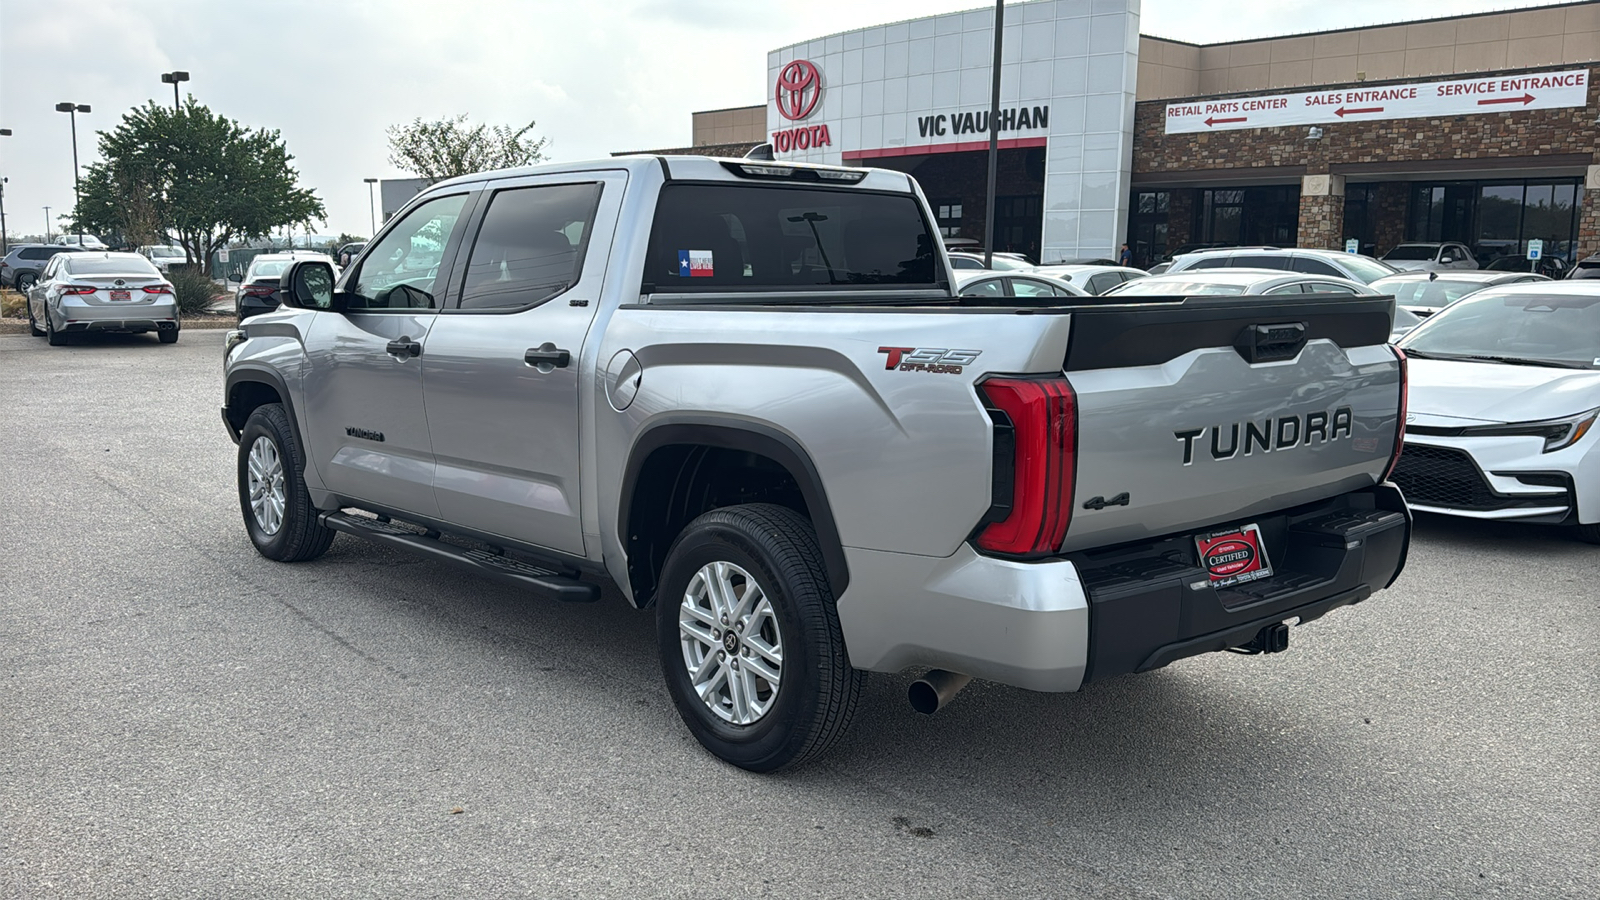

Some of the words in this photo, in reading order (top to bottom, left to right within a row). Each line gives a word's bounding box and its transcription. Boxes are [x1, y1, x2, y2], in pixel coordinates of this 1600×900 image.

[1437, 82, 1496, 96] SERVICE
[1500, 74, 1585, 92] ENTRANCE
[1305, 94, 1342, 106] SALES
[1346, 88, 1418, 103] ENTRANCE
[1167, 105, 1203, 117] RETAIL
[1206, 102, 1239, 114] PARTS
[1242, 98, 1288, 112] CENTER
[918, 115, 946, 137] VIC
[772, 124, 831, 153] TOYOTA
[345, 426, 386, 443] TUNDRA
[1173, 405, 1354, 467] TUNDRA
[1209, 551, 1249, 566] CERTIFIED
